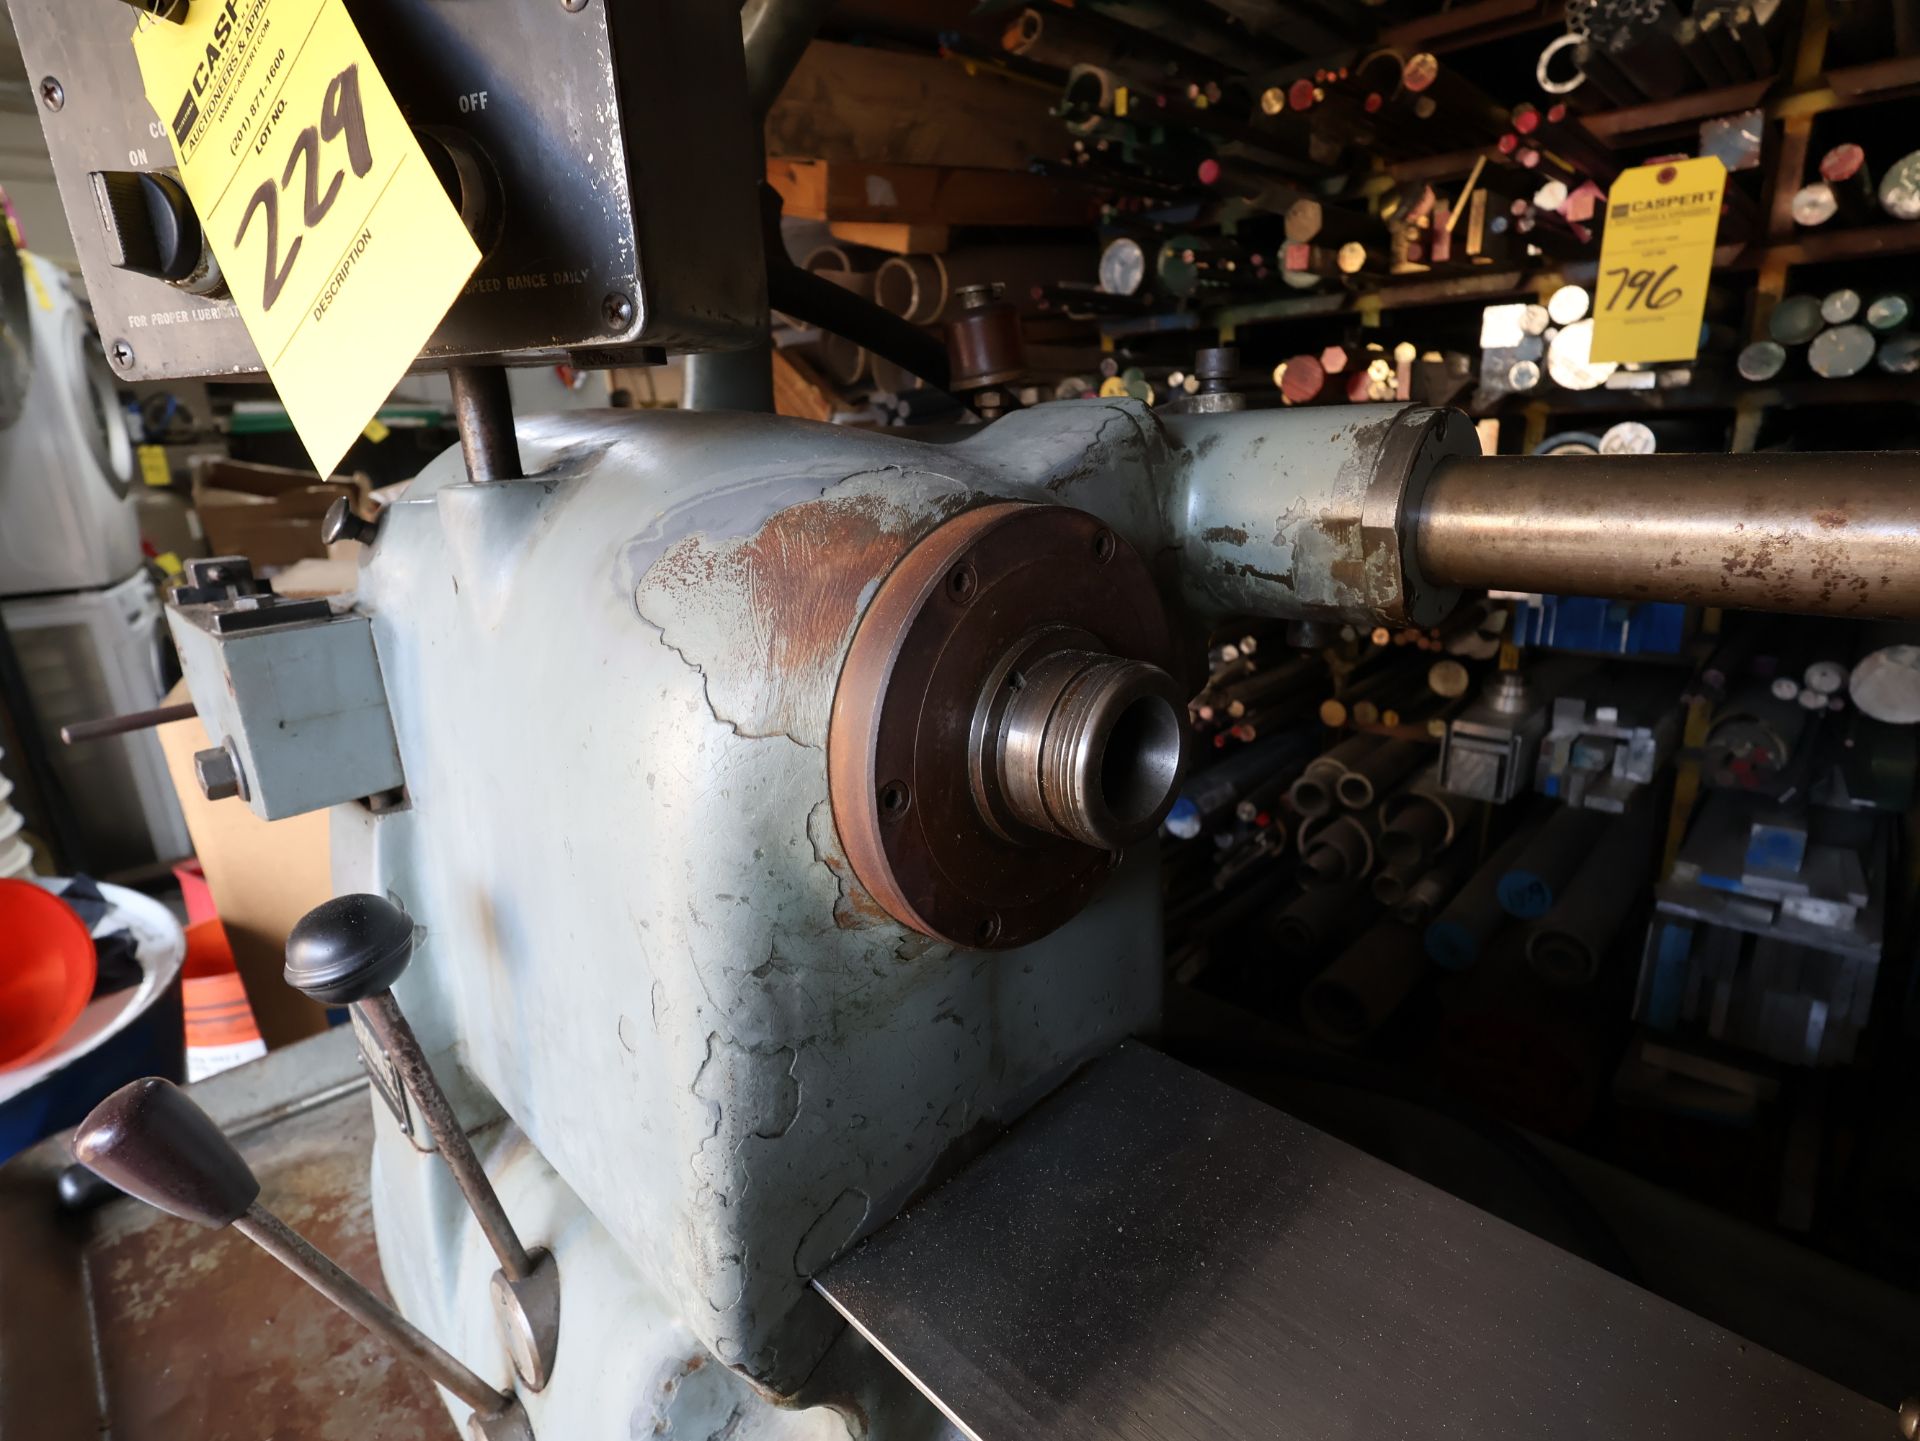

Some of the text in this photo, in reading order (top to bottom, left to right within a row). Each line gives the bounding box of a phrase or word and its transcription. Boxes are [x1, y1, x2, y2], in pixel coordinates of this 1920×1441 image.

[188, 54, 238, 151] AUCTIONEERS
[237, 40, 247, 54] &
[218, 18, 271, 123] WWW.CASPERT.COM
[230, 48, 285, 157] (201) 871-1600
[255, 99, 288, 155] LOT NO.
[458, 91, 488, 113] OFF
[128, 148, 149, 167] ON
[234, 60, 373, 312] 229
[1631, 190, 1718, 214] CASPERT
[313, 228, 373, 322] DESCRIPTION
[553, 268, 590, 286] DAILY
[1605, 264, 1683, 312] 796
[128, 314, 148, 328] FOR
[151, 310, 190, 326] PROPER
